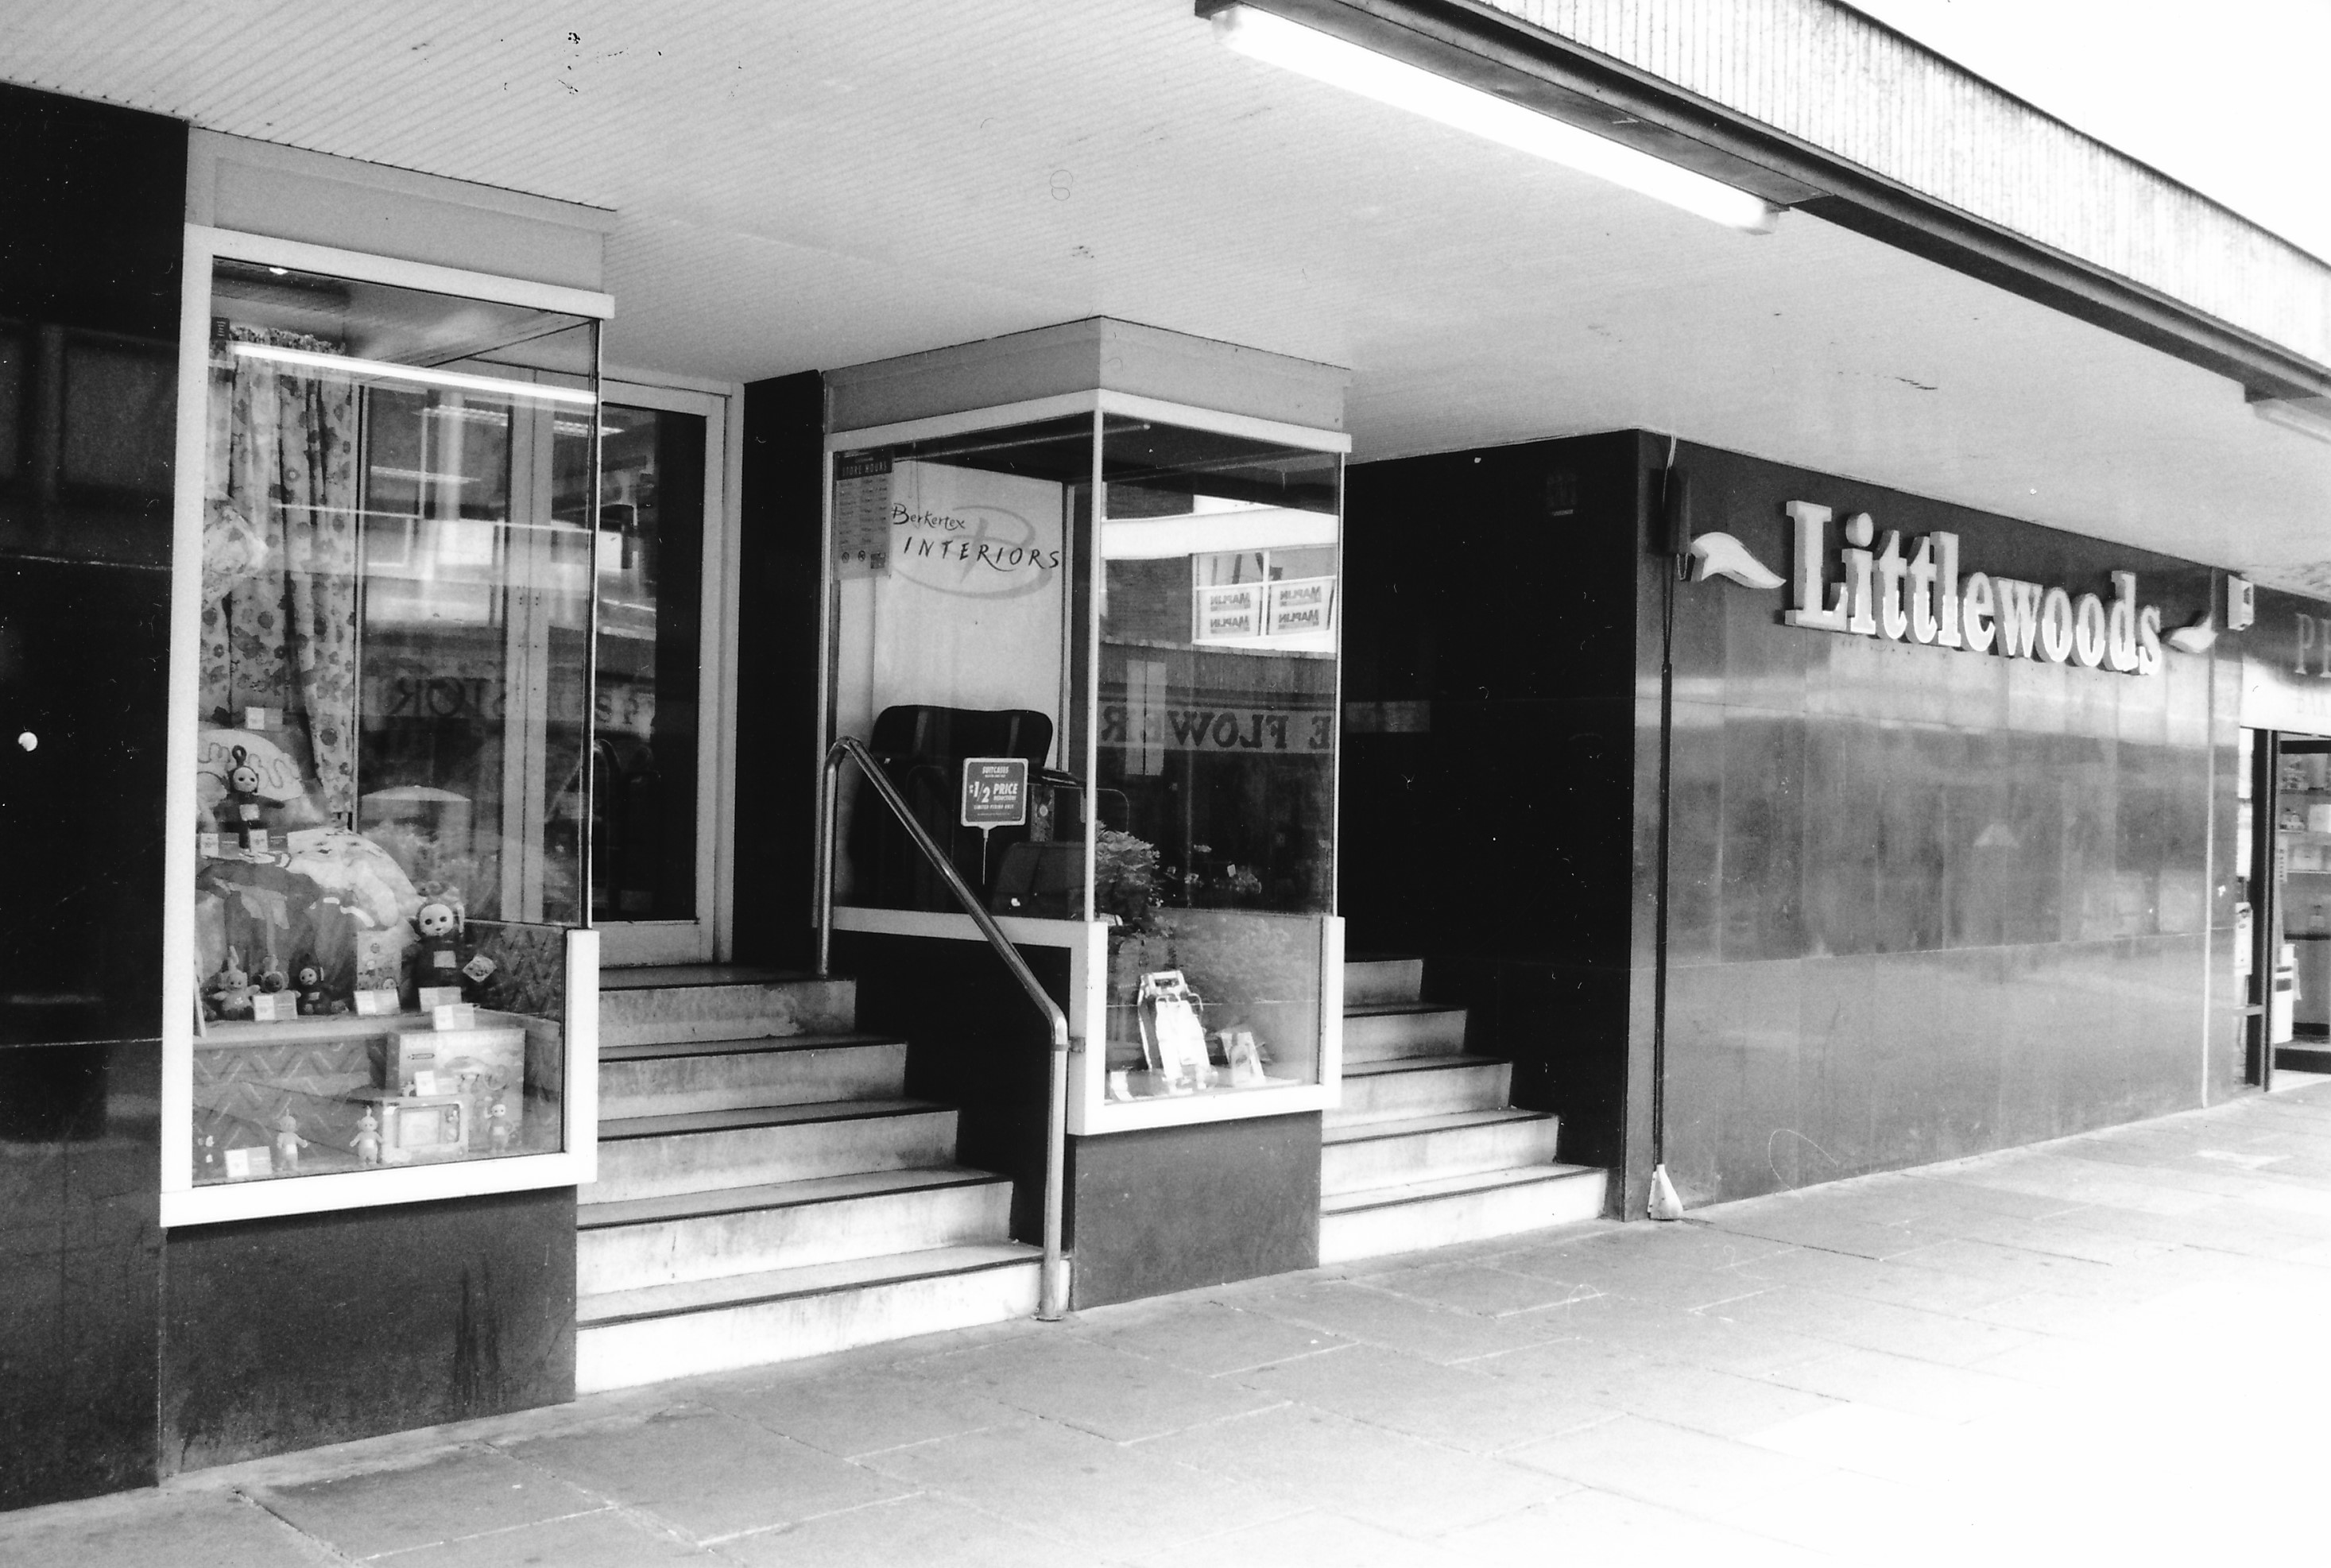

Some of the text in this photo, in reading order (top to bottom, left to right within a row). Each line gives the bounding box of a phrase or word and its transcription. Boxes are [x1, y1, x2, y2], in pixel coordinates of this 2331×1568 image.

[891, 501, 965, 531] Berkertex
[903, 536, 1060, 572] INTERIORS
[1784, 500, 2162, 676] Littlewoods
[993, 783, 1018, 795] PRICE
